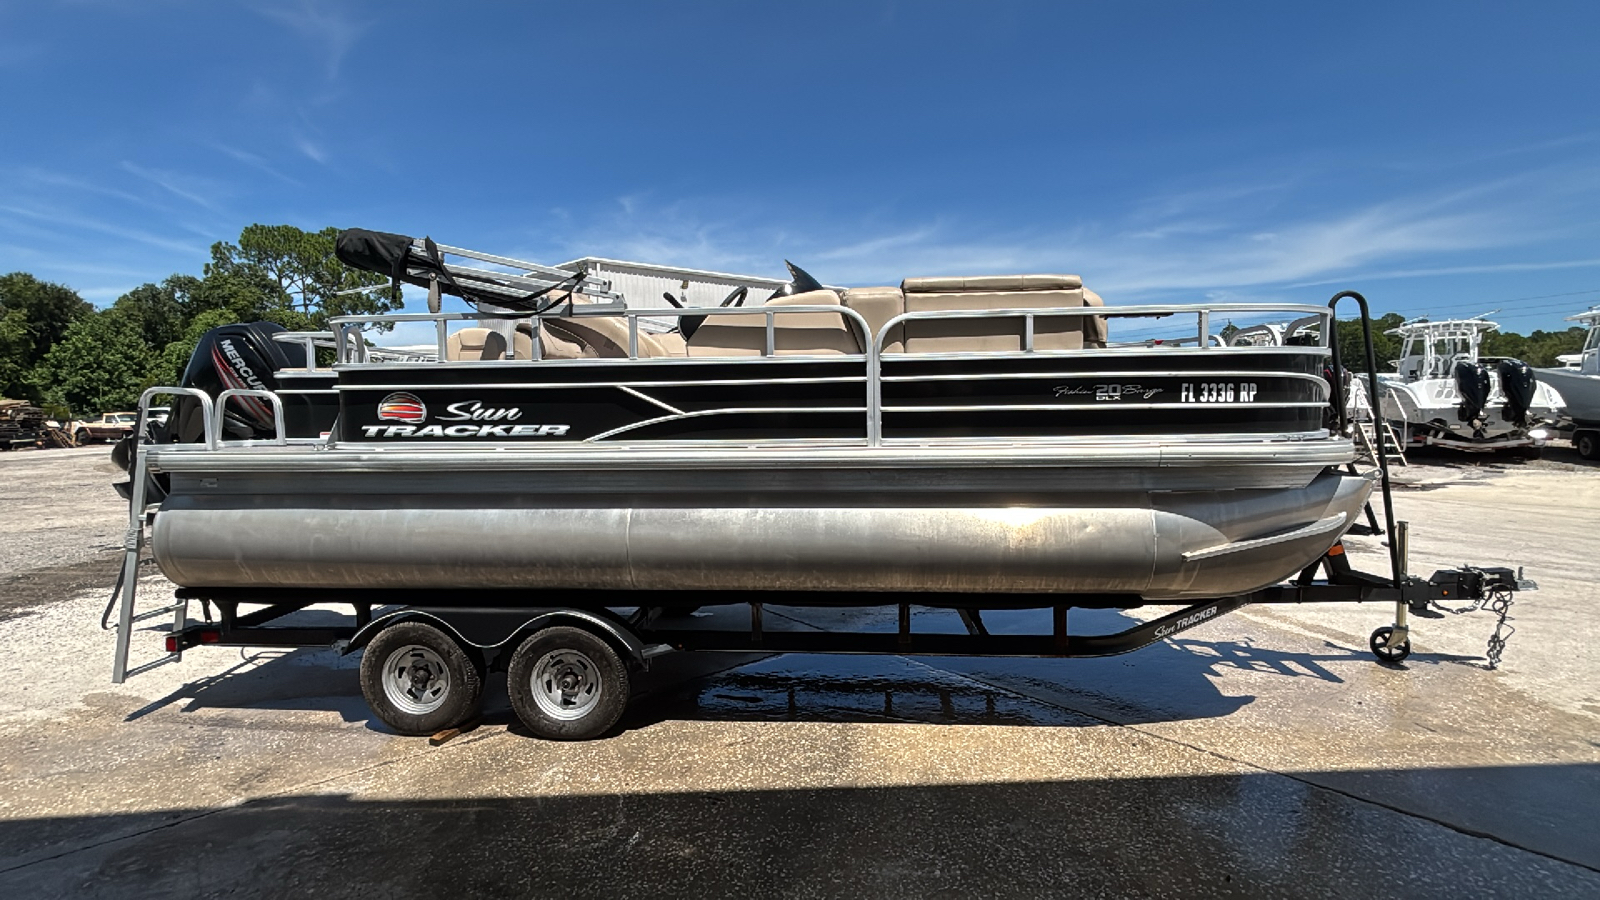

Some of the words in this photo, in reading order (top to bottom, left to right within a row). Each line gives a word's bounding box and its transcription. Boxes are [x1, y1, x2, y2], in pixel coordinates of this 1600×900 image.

[220, 338, 270, 400] MERCUR
[1096, 384, 1121, 395] 20
[1181, 383, 1195, 402] FL
[1200, 383, 1234, 402] 3336
[1240, 383, 1257, 402] RP
[435, 400, 522, 421] Sun
[361, 424, 571, 437] TRACKER
[1152, 625, 1175, 640] Sun
[1176, 606, 1218, 630] TRACKER
